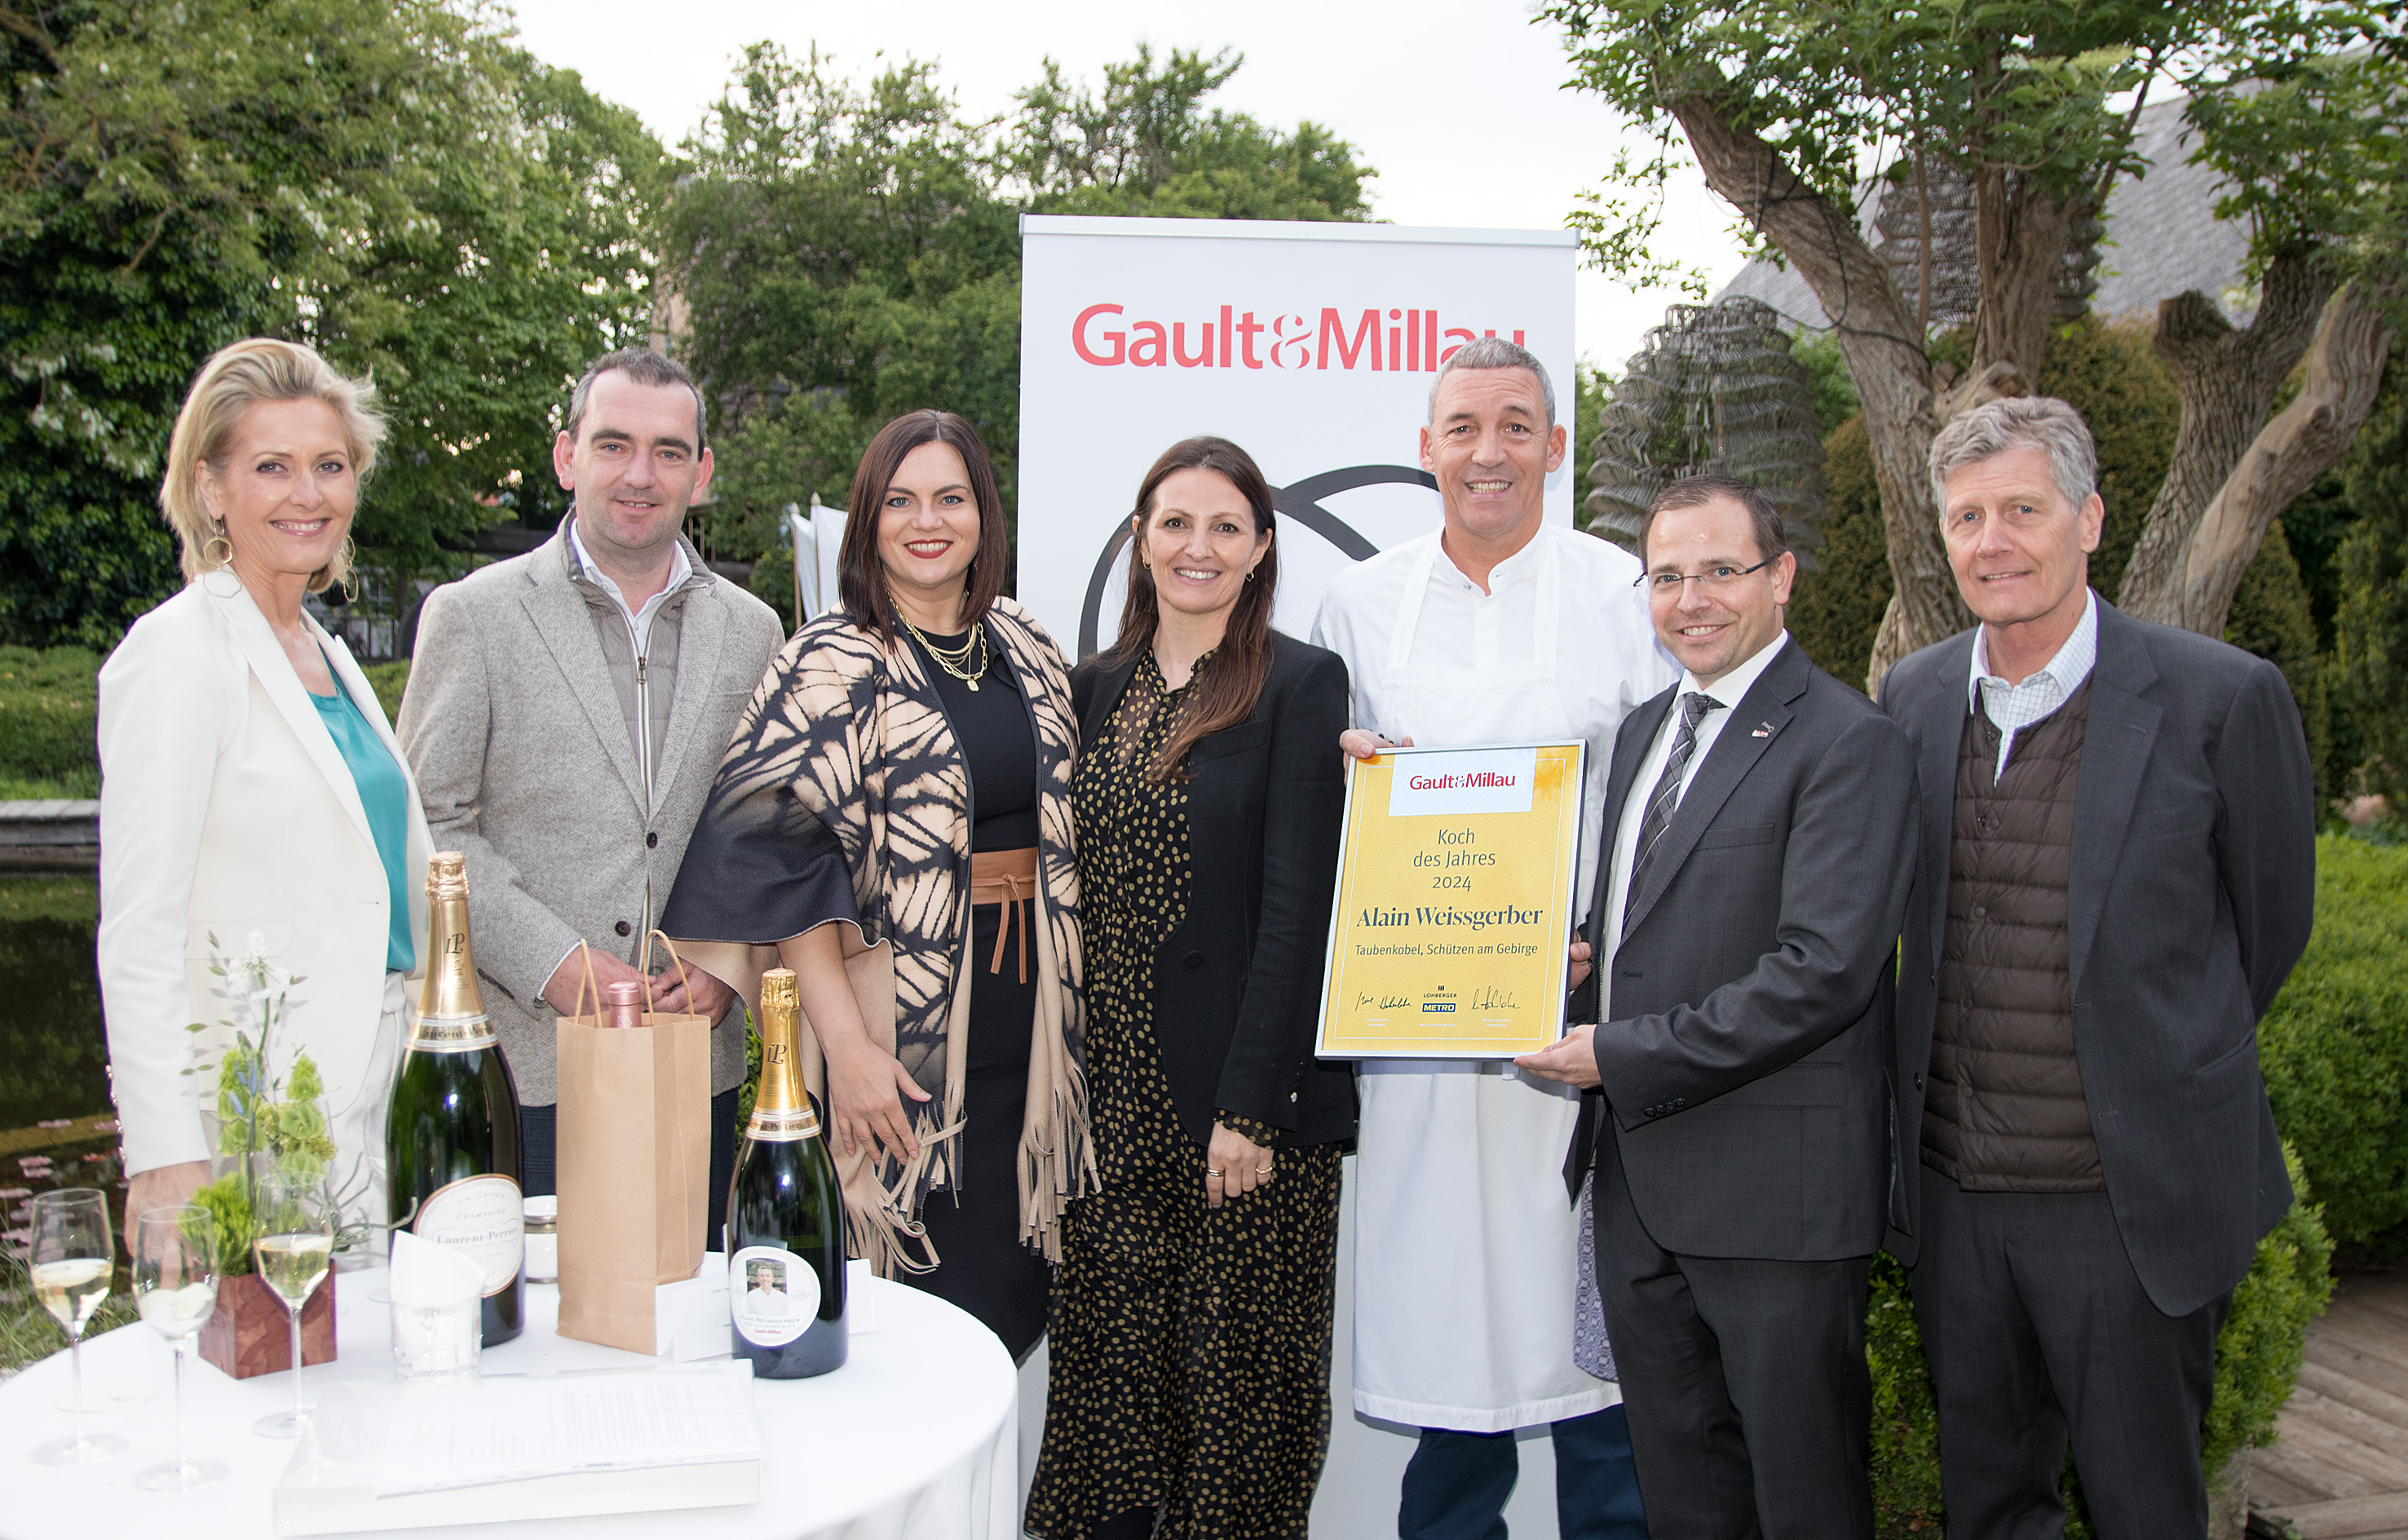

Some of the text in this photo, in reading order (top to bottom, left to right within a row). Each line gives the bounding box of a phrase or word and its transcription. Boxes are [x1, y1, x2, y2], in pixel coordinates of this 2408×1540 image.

[1071, 303, 1525, 373] Gault&Milla
[1409, 772, 1516, 790] Gault&Millau
[1438, 827, 1475, 845] Koch
[1413, 849, 1496, 869] des Jahres
[1432, 875, 1472, 892] 2024
[1356, 905, 1544, 932] Alain Weissgerber
[1355, 942, 1539, 957] Taubenkobel, Schützen am Gebirge
[437, 1226, 519, 1245] Laurent-Perrier
